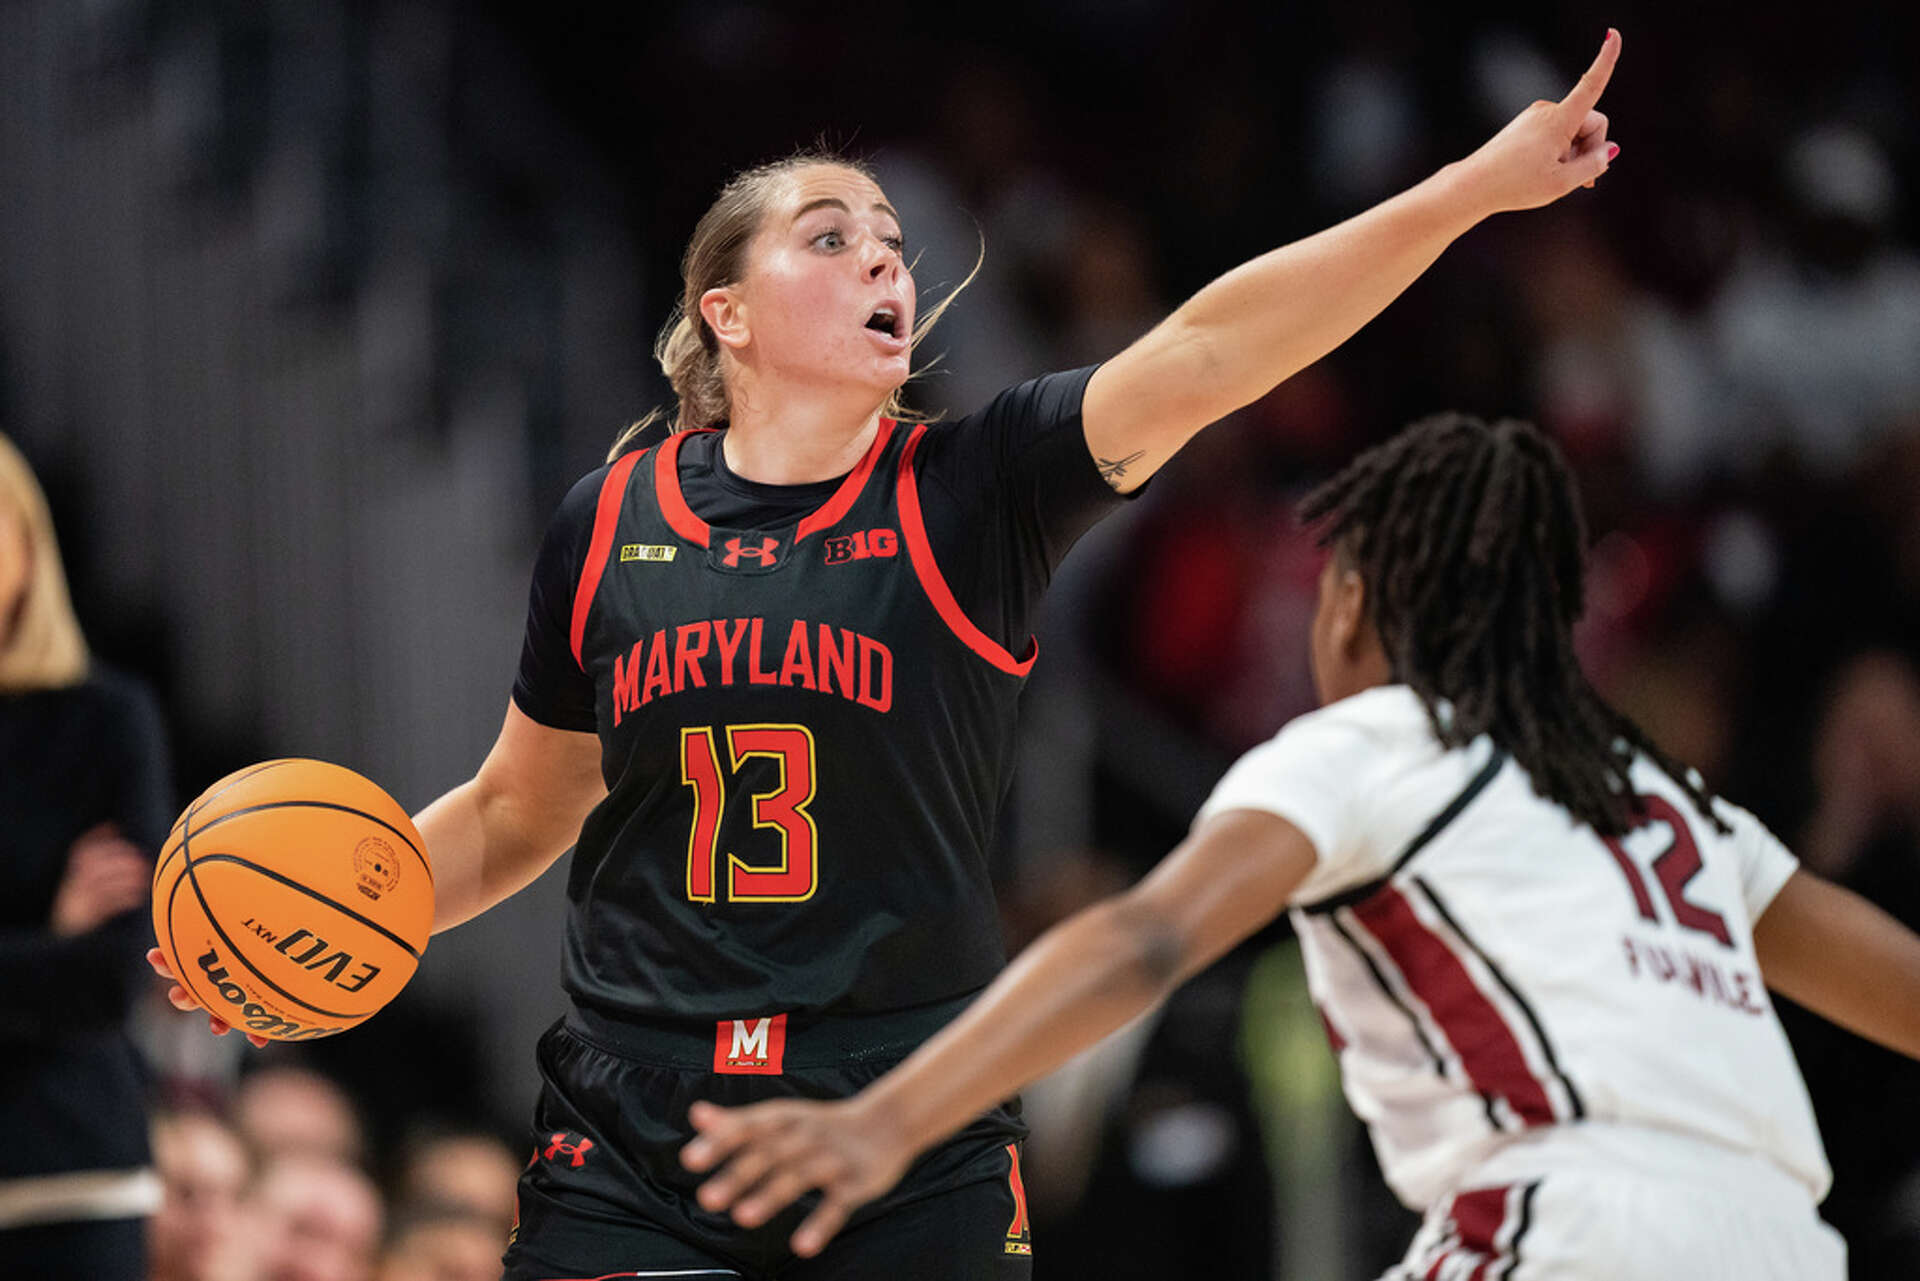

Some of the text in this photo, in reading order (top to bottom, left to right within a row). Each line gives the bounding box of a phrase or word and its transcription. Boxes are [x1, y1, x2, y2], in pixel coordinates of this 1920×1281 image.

[612, 617, 894, 728] MARYLAND
[680, 723, 818, 903] 13
[1598, 793, 1736, 947] 12
[239, 918, 382, 993] EVO NXT
[727, 1017, 772, 1060] M
